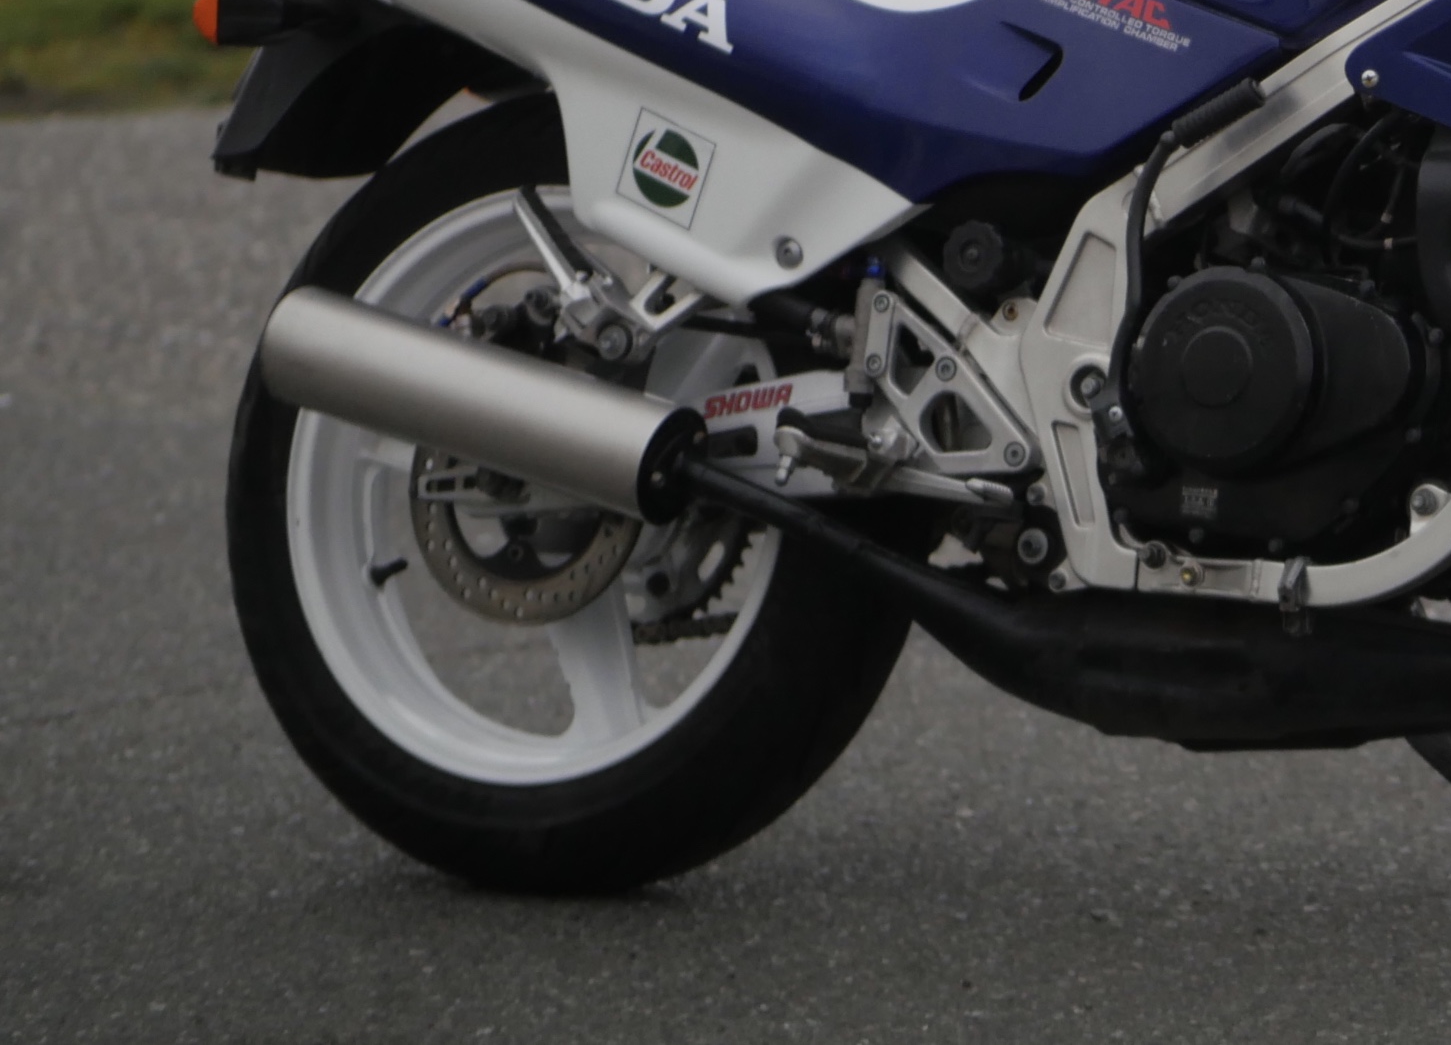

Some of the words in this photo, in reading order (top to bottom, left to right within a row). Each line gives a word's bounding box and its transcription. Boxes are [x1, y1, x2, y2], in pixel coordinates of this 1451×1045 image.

[1123, 25, 1179, 52] CHAMBER
[1145, 23, 1192, 48] TORQUE
[639, 149, 699, 191] Castrol
[703, 383, 793, 420] SHOWA
